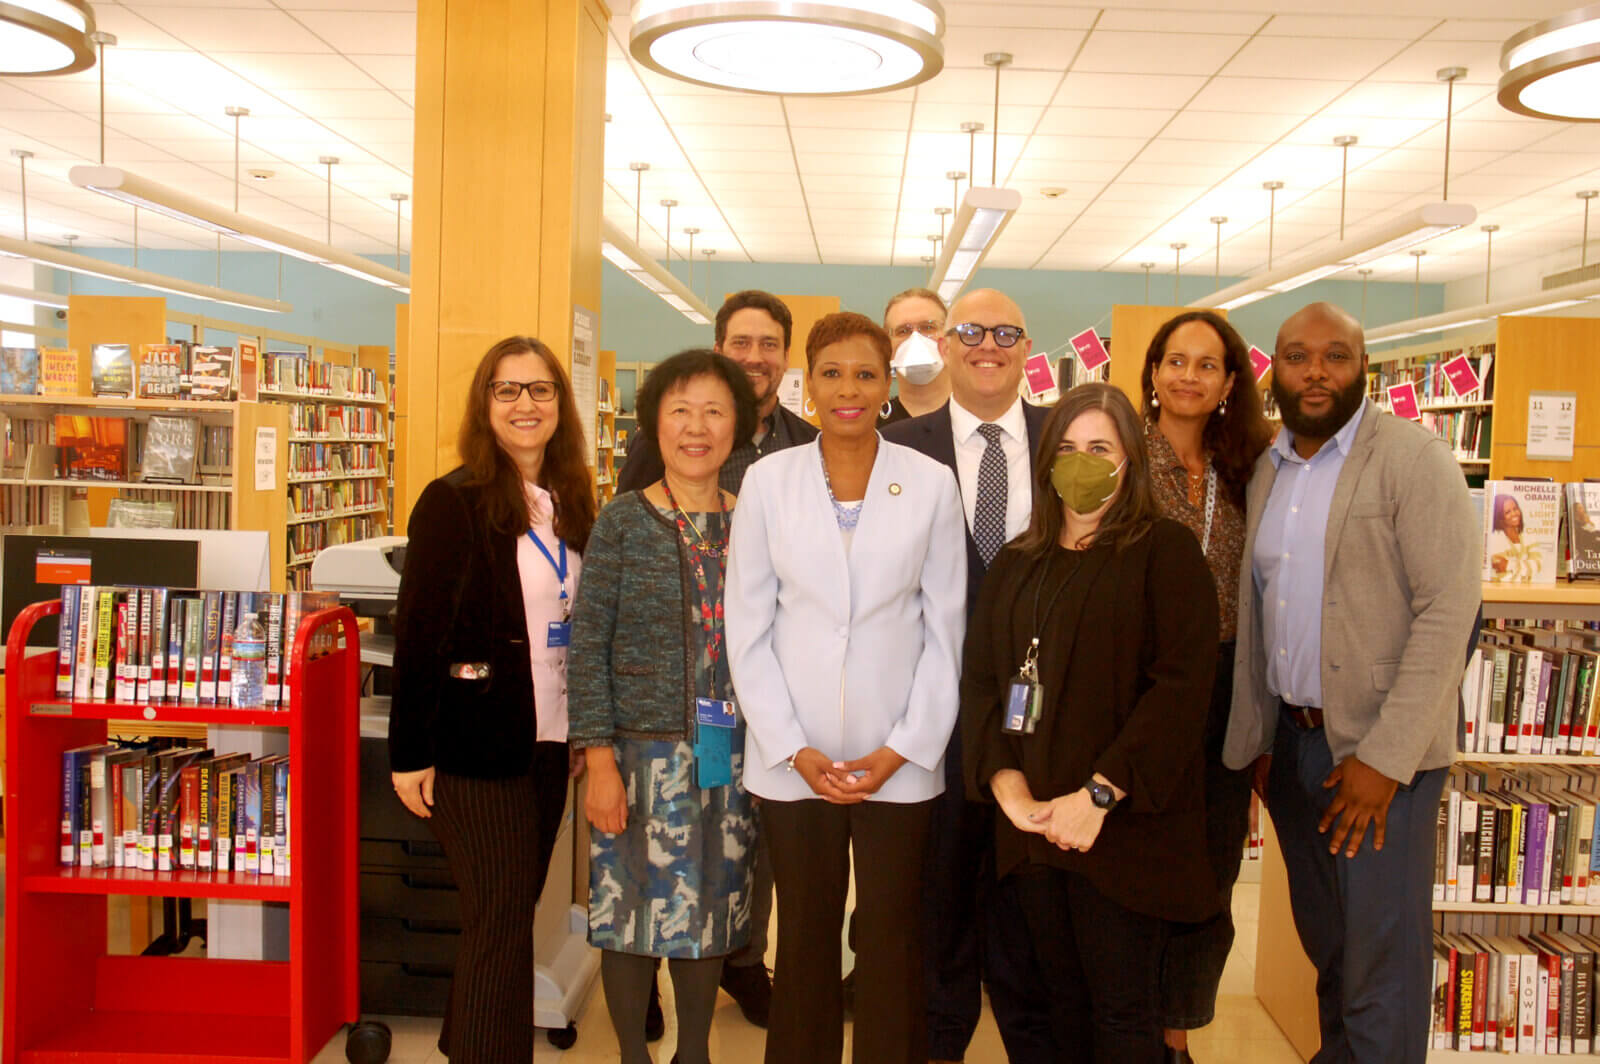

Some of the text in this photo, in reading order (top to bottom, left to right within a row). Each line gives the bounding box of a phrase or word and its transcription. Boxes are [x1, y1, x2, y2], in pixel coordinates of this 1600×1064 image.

[145, 352, 176, 364] JACK
[144, 366, 177, 376] CARR
[147, 383, 173, 394] DEAD
[1532, 401, 1543, 410] 11
[1561, 402, 1572, 410] 12
[102, 597, 110, 608] THE
[270, 604, 280, 621] IRIS
[208, 609, 218, 640] GIFTS
[1536, 702, 1545, 724] CUZ
[200, 792, 208, 824] KOONTZ
[1480, 810, 1493, 857] BELICHICK
[1459, 969, 1474, 1030] SURRENDER
[1576, 972, 1587, 1035] BRANDEIS
